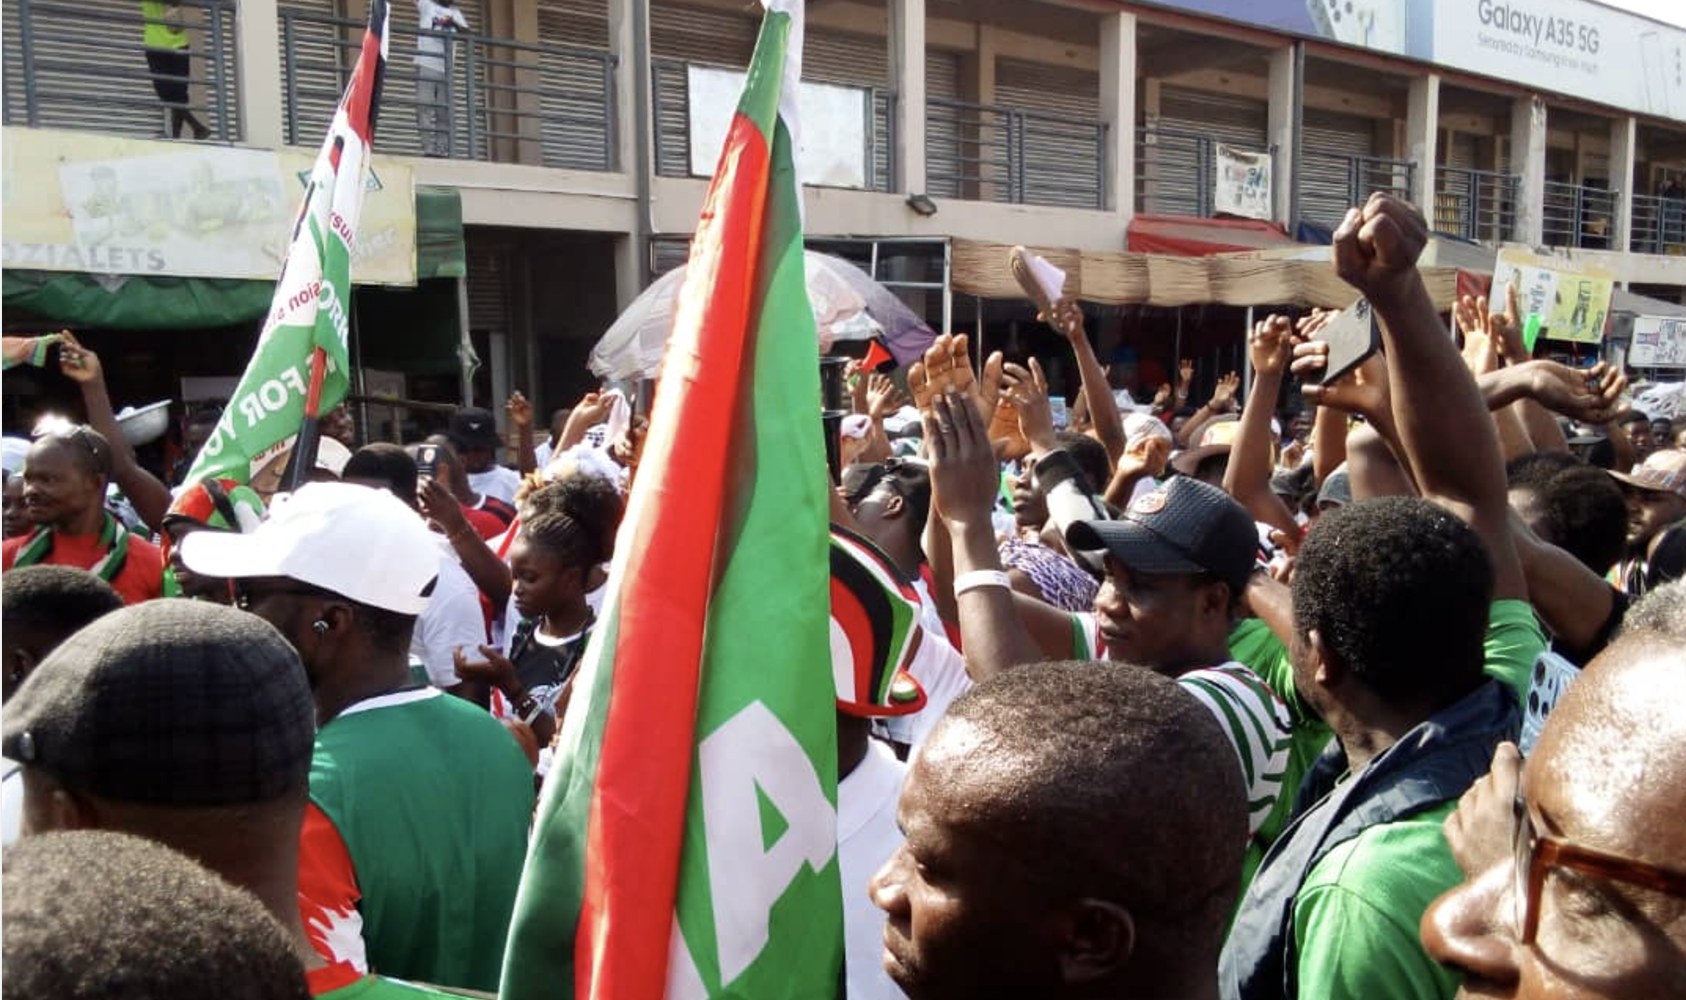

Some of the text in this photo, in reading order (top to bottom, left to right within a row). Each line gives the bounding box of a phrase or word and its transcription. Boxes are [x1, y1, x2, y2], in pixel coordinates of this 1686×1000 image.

[1478, 0, 1600, 55] Galaxy A35 5G
